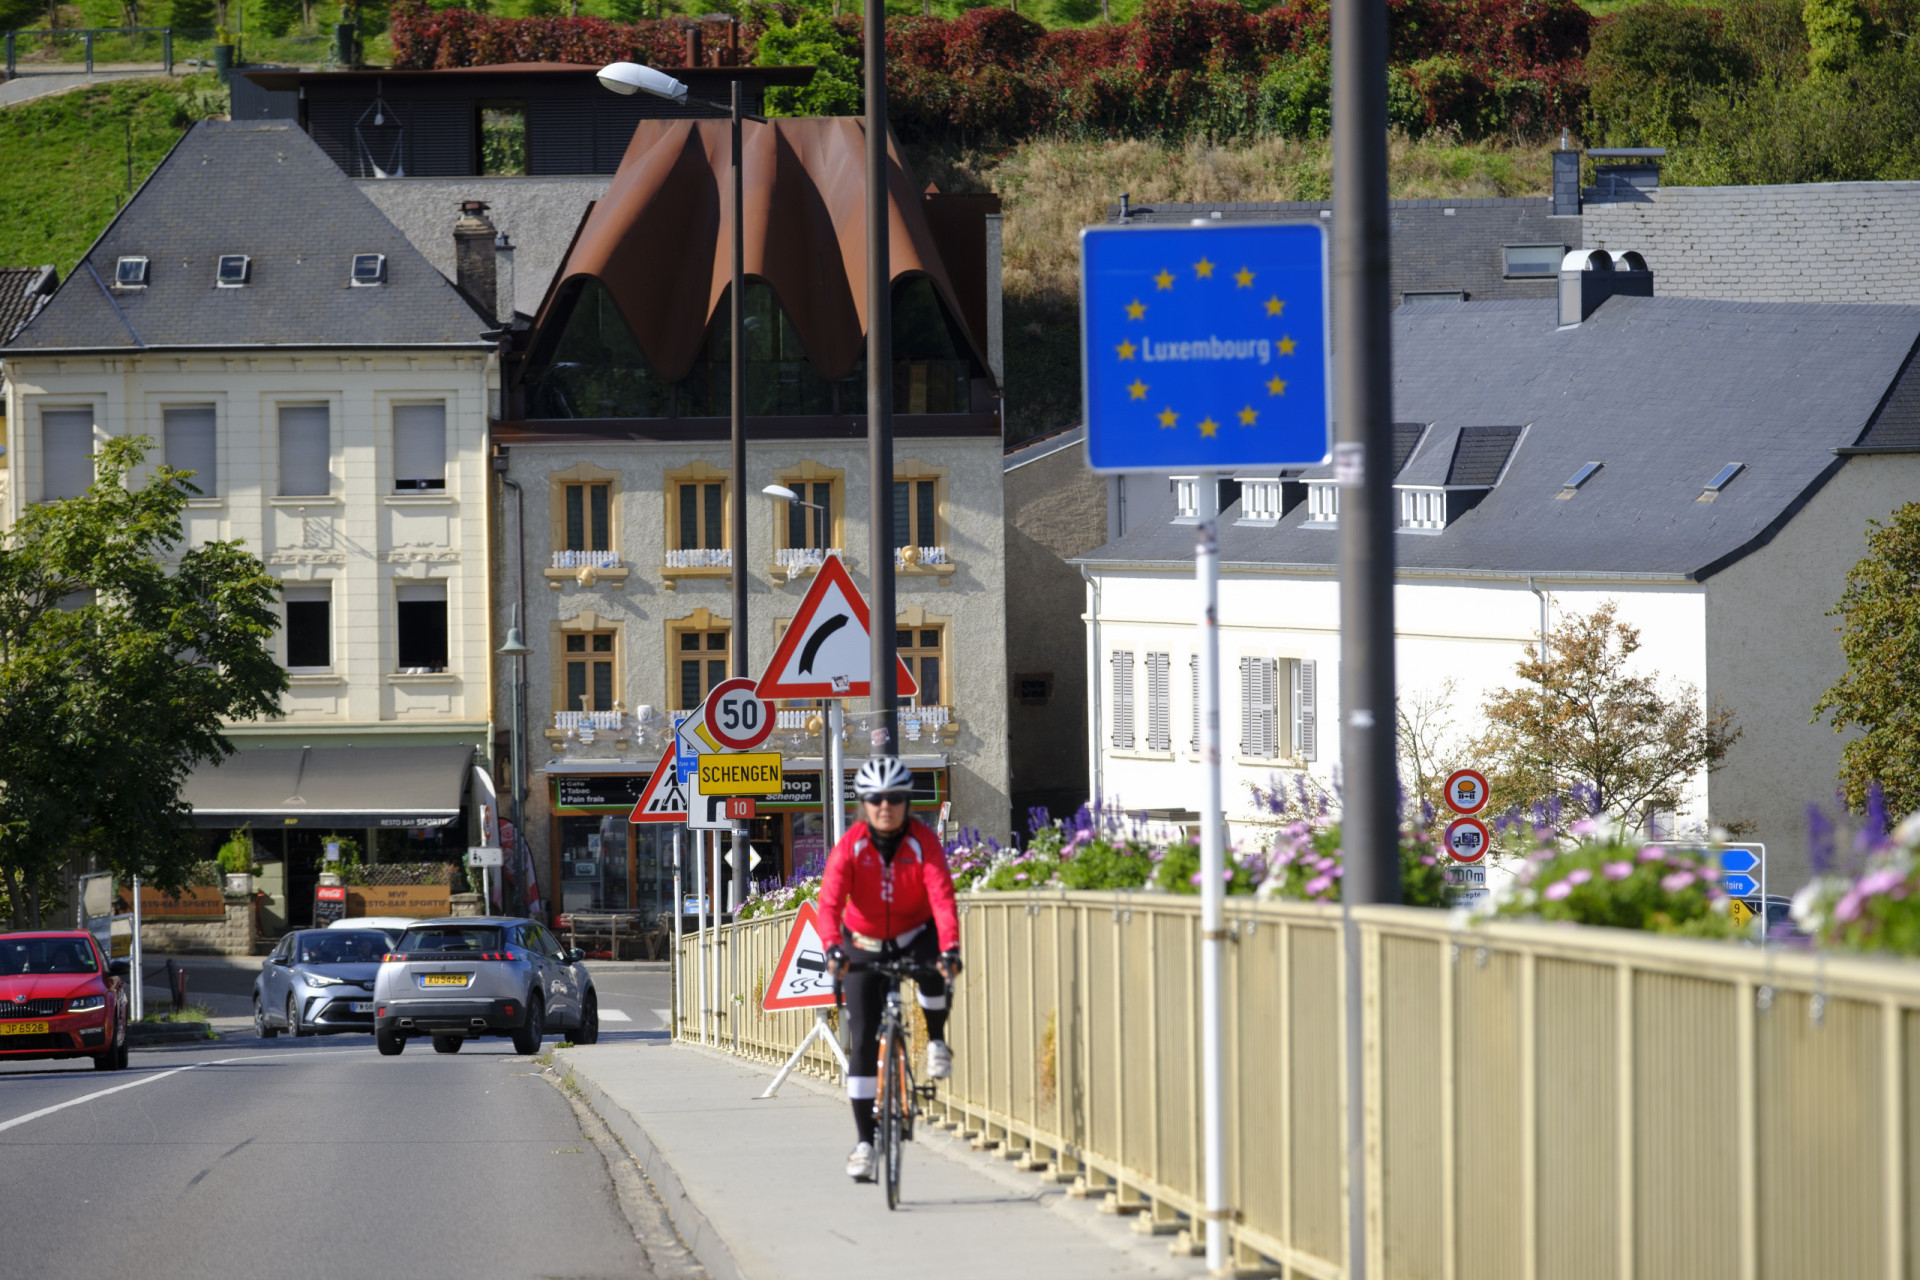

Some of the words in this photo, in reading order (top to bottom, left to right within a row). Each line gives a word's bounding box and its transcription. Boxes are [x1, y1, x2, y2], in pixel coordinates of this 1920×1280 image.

[1142, 336, 1270, 365] Luxembourg
[723, 699, 757, 730] 50
[702, 765, 779, 783] SCHENGEN
[782, 780, 812, 792] hop
[567, 795, 585, 803] Pain
[586, 795, 605, 803] frais
[765, 793, 812, 802] Schengen
[733, 801, 747, 815] 10
[380, 818, 401, 826] RESTO
[402, 818, 415, 826] BAR
[416, 816, 450, 826] SPORTIF
[409, 899, 447, 907] SPORTIF
[1734, 903, 1740, 914] 9
[6, 1025, 17, 1034] JP
[19, 1023, 44, 1033] 6528
